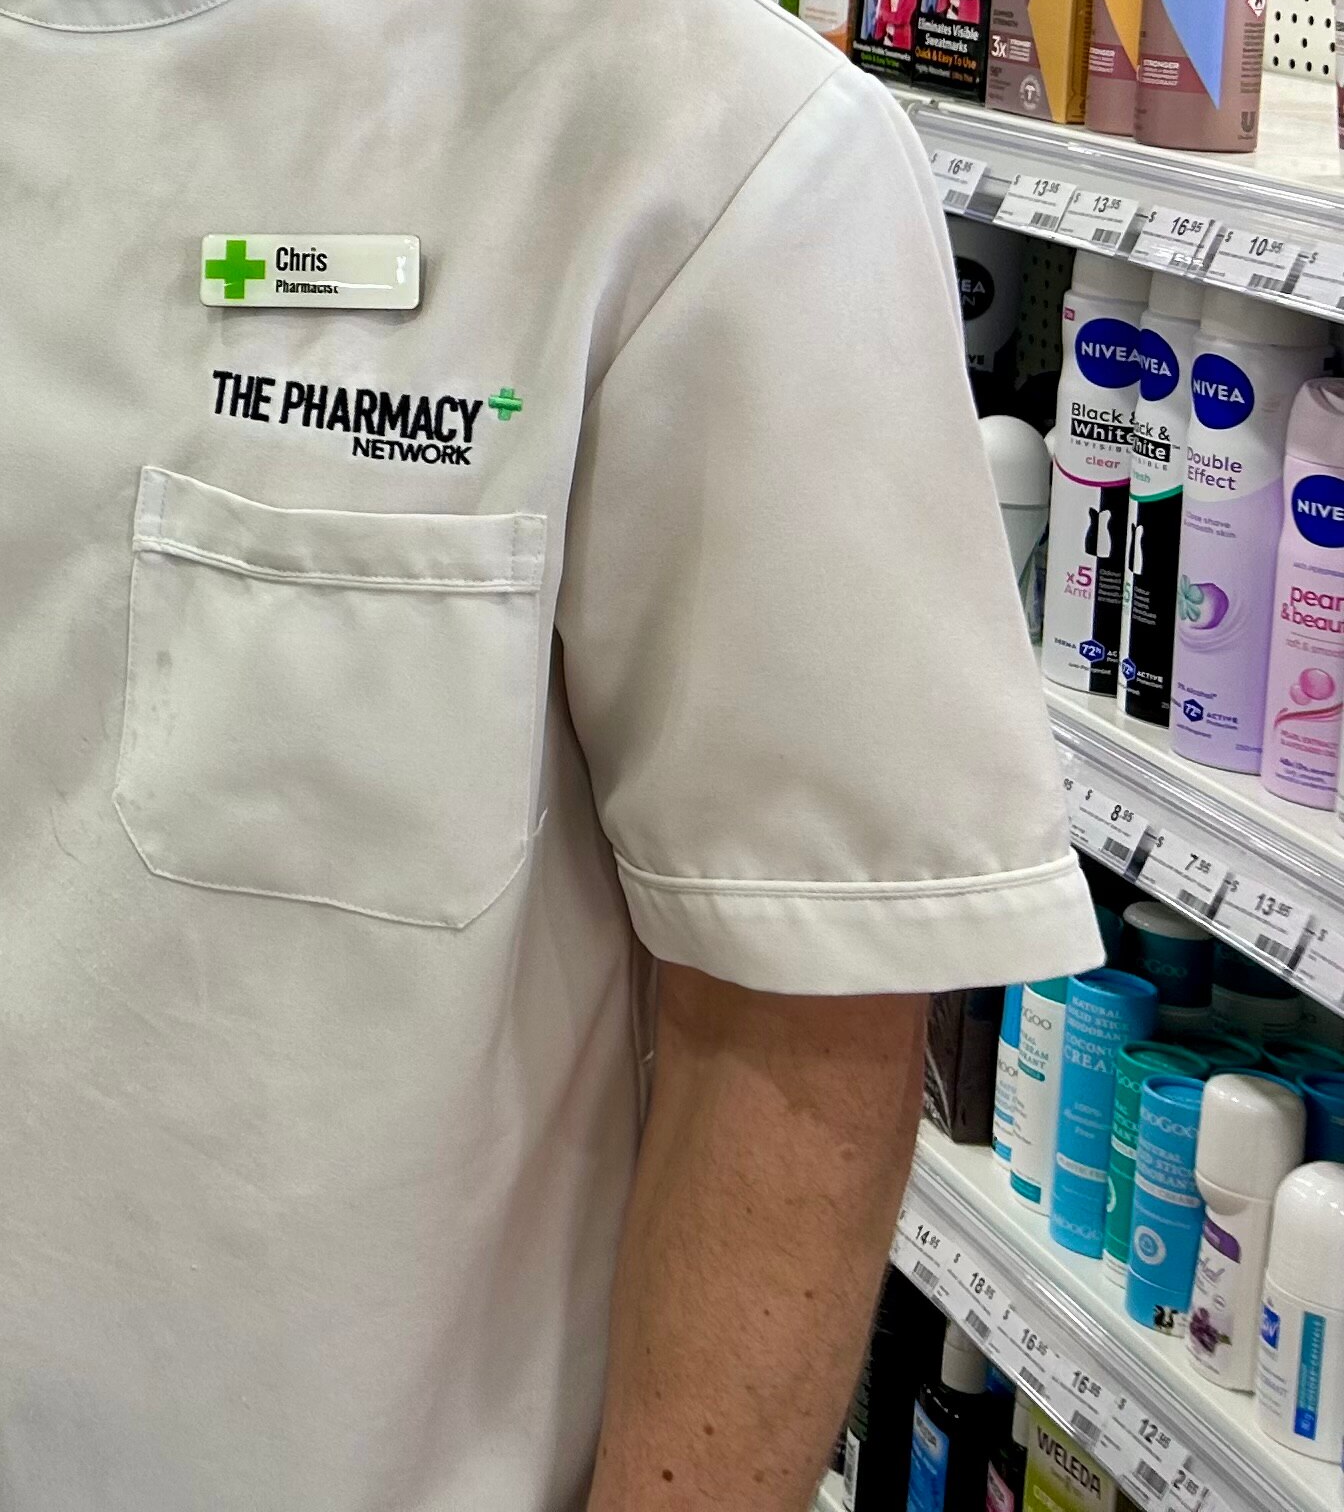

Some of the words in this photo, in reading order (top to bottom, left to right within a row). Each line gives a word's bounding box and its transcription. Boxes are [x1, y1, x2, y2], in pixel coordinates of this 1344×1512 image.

[991, 35, 1007, 58] 3x
[275, 247, 328, 272] Chris
[1080, 341, 1141, 364] NIVEA
[1193, 378, 1245, 406] NIVEA
[213, 369, 276, 422] THE
[279, 380, 484, 443] PHARMACY
[1071, 402, 1123, 425] Black
[1072, 420, 1136, 446] White
[1158, 426, 1170, 442] &
[352, 436, 472, 466] NETWORK
[1085, 454, 1121, 469] clear
[1186, 446, 1243, 473] Double
[1187, 465, 1237, 491] Effect
[1297, 498, 1344, 522] NIVE
[1066, 566, 1093, 587] x5
[1290, 585, 1344, 613] pear
[1037, 1426, 1102, 1500] WELEDA
